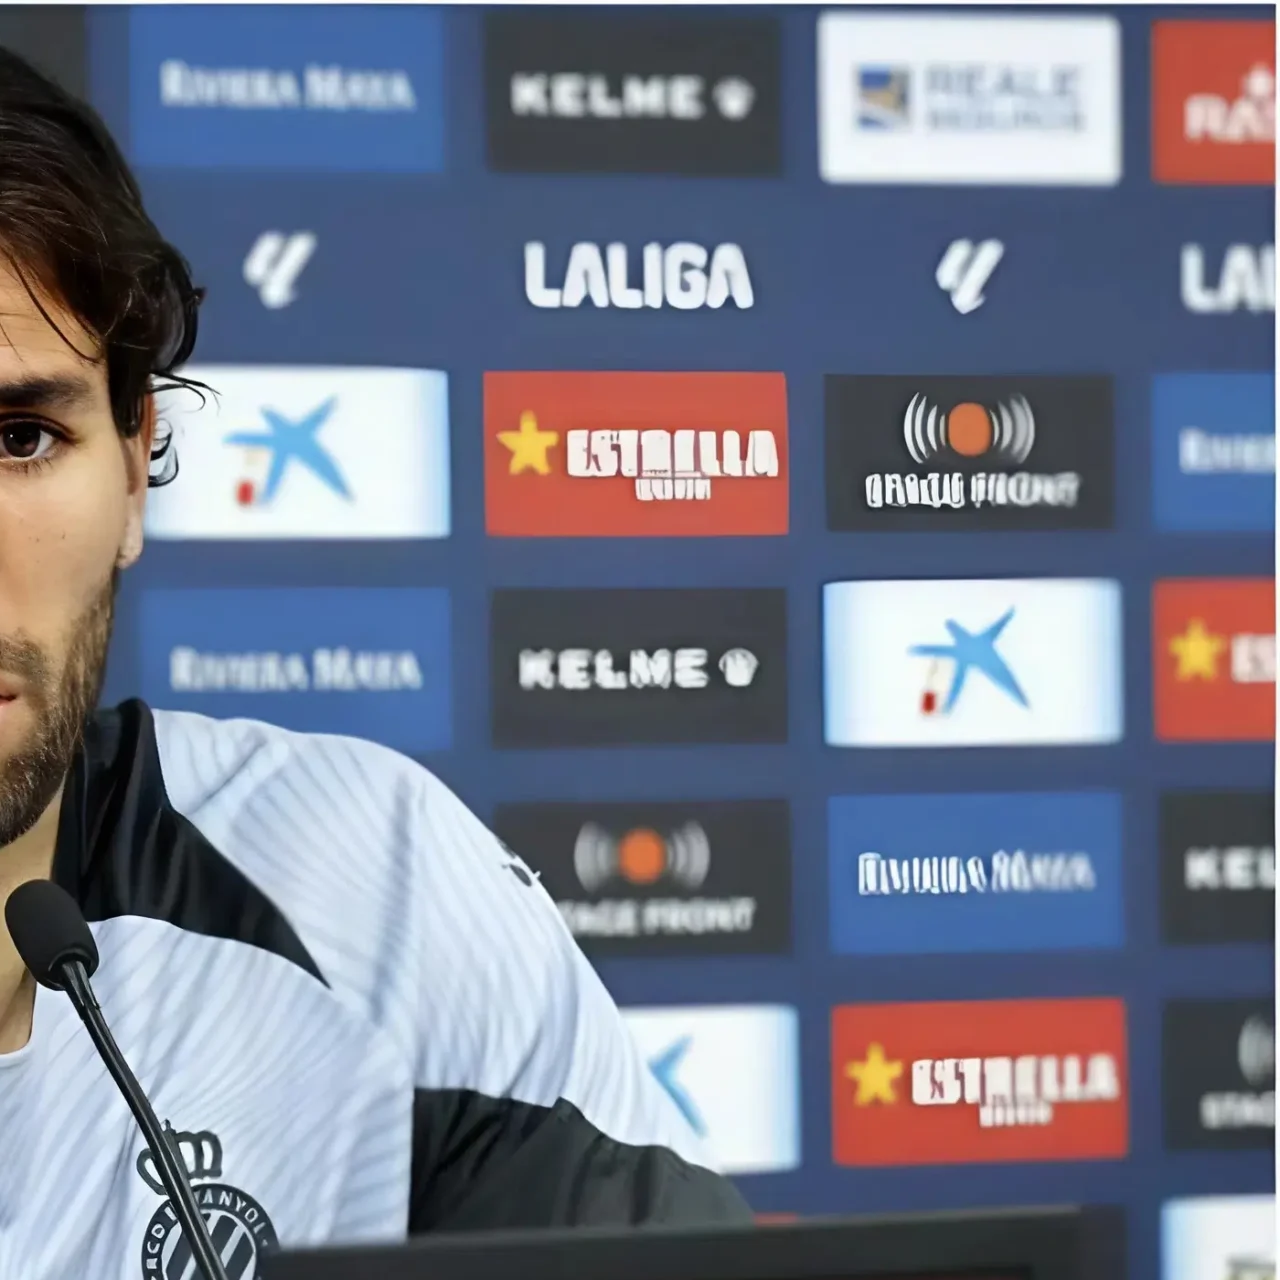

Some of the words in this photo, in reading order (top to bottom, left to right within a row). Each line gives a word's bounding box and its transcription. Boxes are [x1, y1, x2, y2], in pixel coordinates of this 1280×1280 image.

[511, 70, 705, 121] KELME
[1184, 94, 1275, 142] RA
[524, 239, 754, 310] LALIGA
[518, 648, 708, 689] KELME
